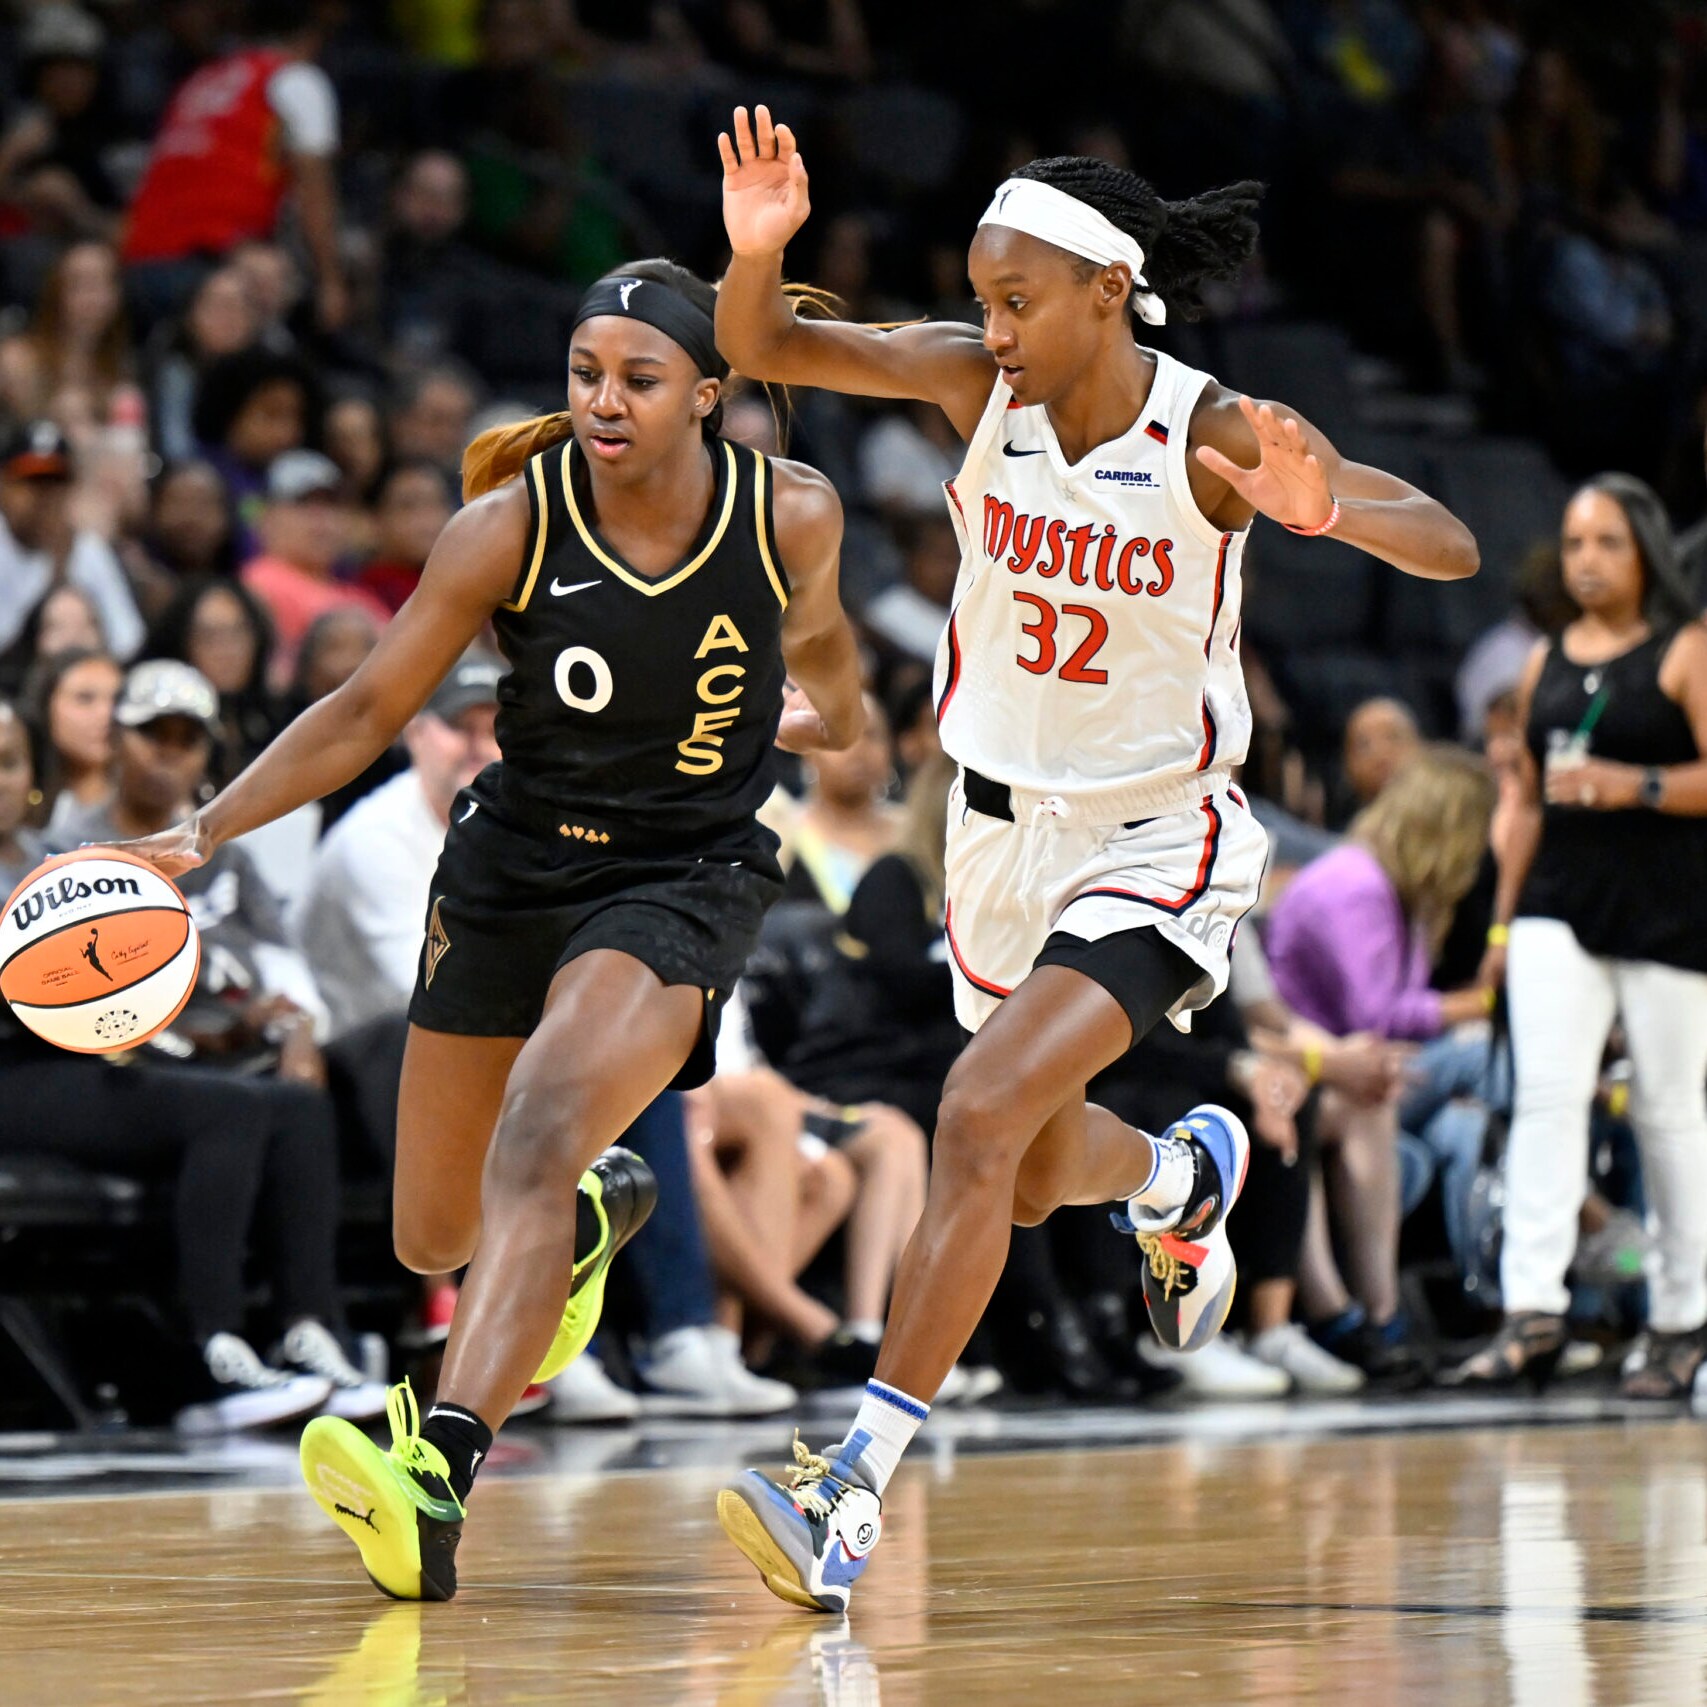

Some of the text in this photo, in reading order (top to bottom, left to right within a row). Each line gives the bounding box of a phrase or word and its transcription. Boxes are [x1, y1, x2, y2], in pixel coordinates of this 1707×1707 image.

[1012, 590, 1109, 685] 32
[554, 645, 614, 713] 0
[674, 614, 750, 776] ACES
[11, 876, 143, 931] Wilson
